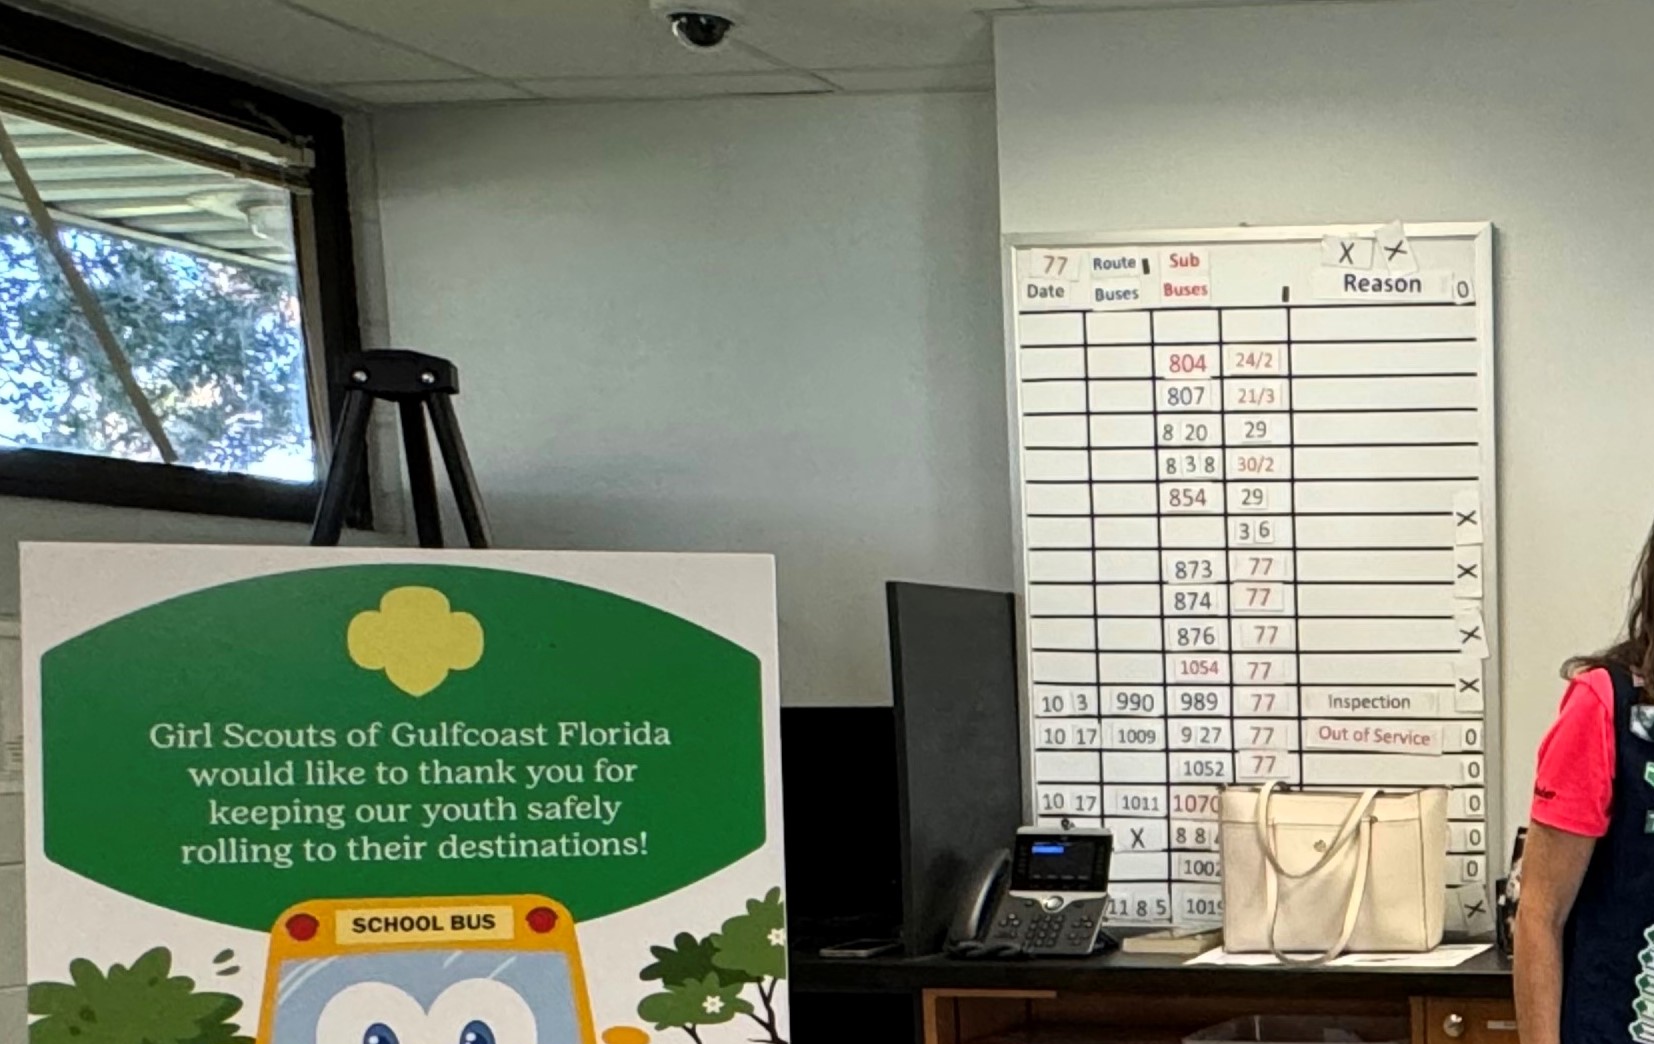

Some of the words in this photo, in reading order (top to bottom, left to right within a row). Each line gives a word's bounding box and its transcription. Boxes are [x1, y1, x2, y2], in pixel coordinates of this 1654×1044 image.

[1043, 255, 1069, 275] 77
[1092, 255, 1137, 271] Route
[1169, 252, 1200, 268] Sub
[1027, 283, 1065, 299] Date
[1163, 281, 1209, 298] Buses
[1343, 274, 1423, 294] Reason
[1094, 286, 1140, 302] Buses
[1168, 354, 1208, 373] 804
[1234, 352, 1274, 369] 24/2
[1166, 386, 1206, 406] 807
[1237, 387, 1276, 405] 21/3
[1243, 421, 1268, 439] 29
[1236, 456, 1275, 473] 30/2
[1168, 488, 1208, 508] 854
[1240, 488, 1265, 506] 29
[1174, 560, 1214, 579] 873
[1248, 557, 1274, 576] 77
[1173, 591, 1213, 611] 874
[1247, 588, 1272, 606] 77
[1176, 627, 1216, 646] 876
[1253, 626, 1280, 645] 77
[1180, 659, 1220, 677] 1054
[1247, 661, 1273, 680] 77
[1041, 695, 1065, 713] 10
[1076, 693, 1089, 711] 3
[1116, 691, 1156, 712] 990
[1179, 692, 1219, 712] 989
[1251, 693, 1277, 713] 77
[1327, 692, 1411, 711] Inspection
[149, 721, 213, 749] Girl
[223, 720, 337, 749] Scouts
[346, 720, 382, 748] of
[391, 720, 548, 749] Gulfcoast
[557, 720, 672, 748] Florida
[1043, 727, 1067, 745] 10
[1075, 727, 1098, 745] 17
[1117, 728, 1157, 745] 1009
[1249, 726, 1276, 745] 77
[1318, 725, 1350, 742] Out
[1352, 725, 1371, 742] of
[1373, 727, 1432, 746] Service
[187, 760, 295, 787] would
[305, 759, 366, 786] like
[376, 762, 409, 786] to
[418, 758, 518, 786] thank
[526, 763, 584, 790] you
[593, 757, 638, 784] for
[1182, 760, 1226, 777] 1052
[1252, 755, 1278, 774] 77
[1042, 792, 1066, 811] 10
[1074, 794, 1098, 812] 17
[1121, 794, 1160, 811] 1011
[207, 798, 345, 832] keeping
[355, 802, 412, 825] our
[422, 796, 519, 829] youth
[527, 795, 623, 828] safely
[180, 838, 294, 870] rolling
[304, 840, 337, 864] to
[346, 836, 428, 863] their
[437, 831, 649, 861] destinations!
[351, 913, 444, 934] SCHOOL
[450, 911, 497, 932] BUS
